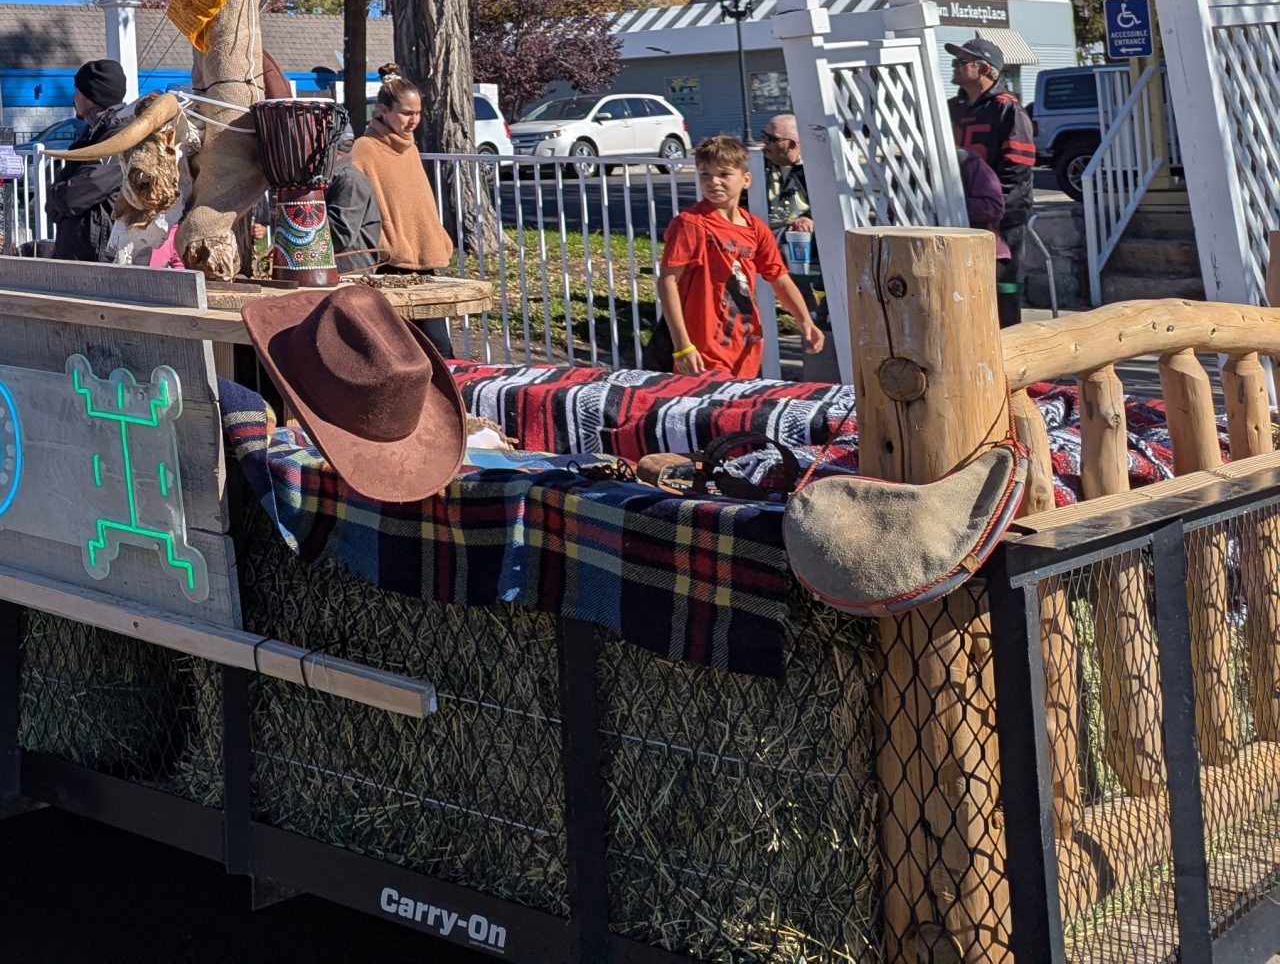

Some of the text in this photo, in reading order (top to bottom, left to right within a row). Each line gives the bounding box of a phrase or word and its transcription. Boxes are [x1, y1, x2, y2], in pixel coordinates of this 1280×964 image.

[950, 2, 1007, 23] Marketplace
[1111, 30, 1148, 39] ACCESSIBLE
[1114, 38, 1146, 46] ENTRANCE
[380, 887, 507, 948] Carry-On
